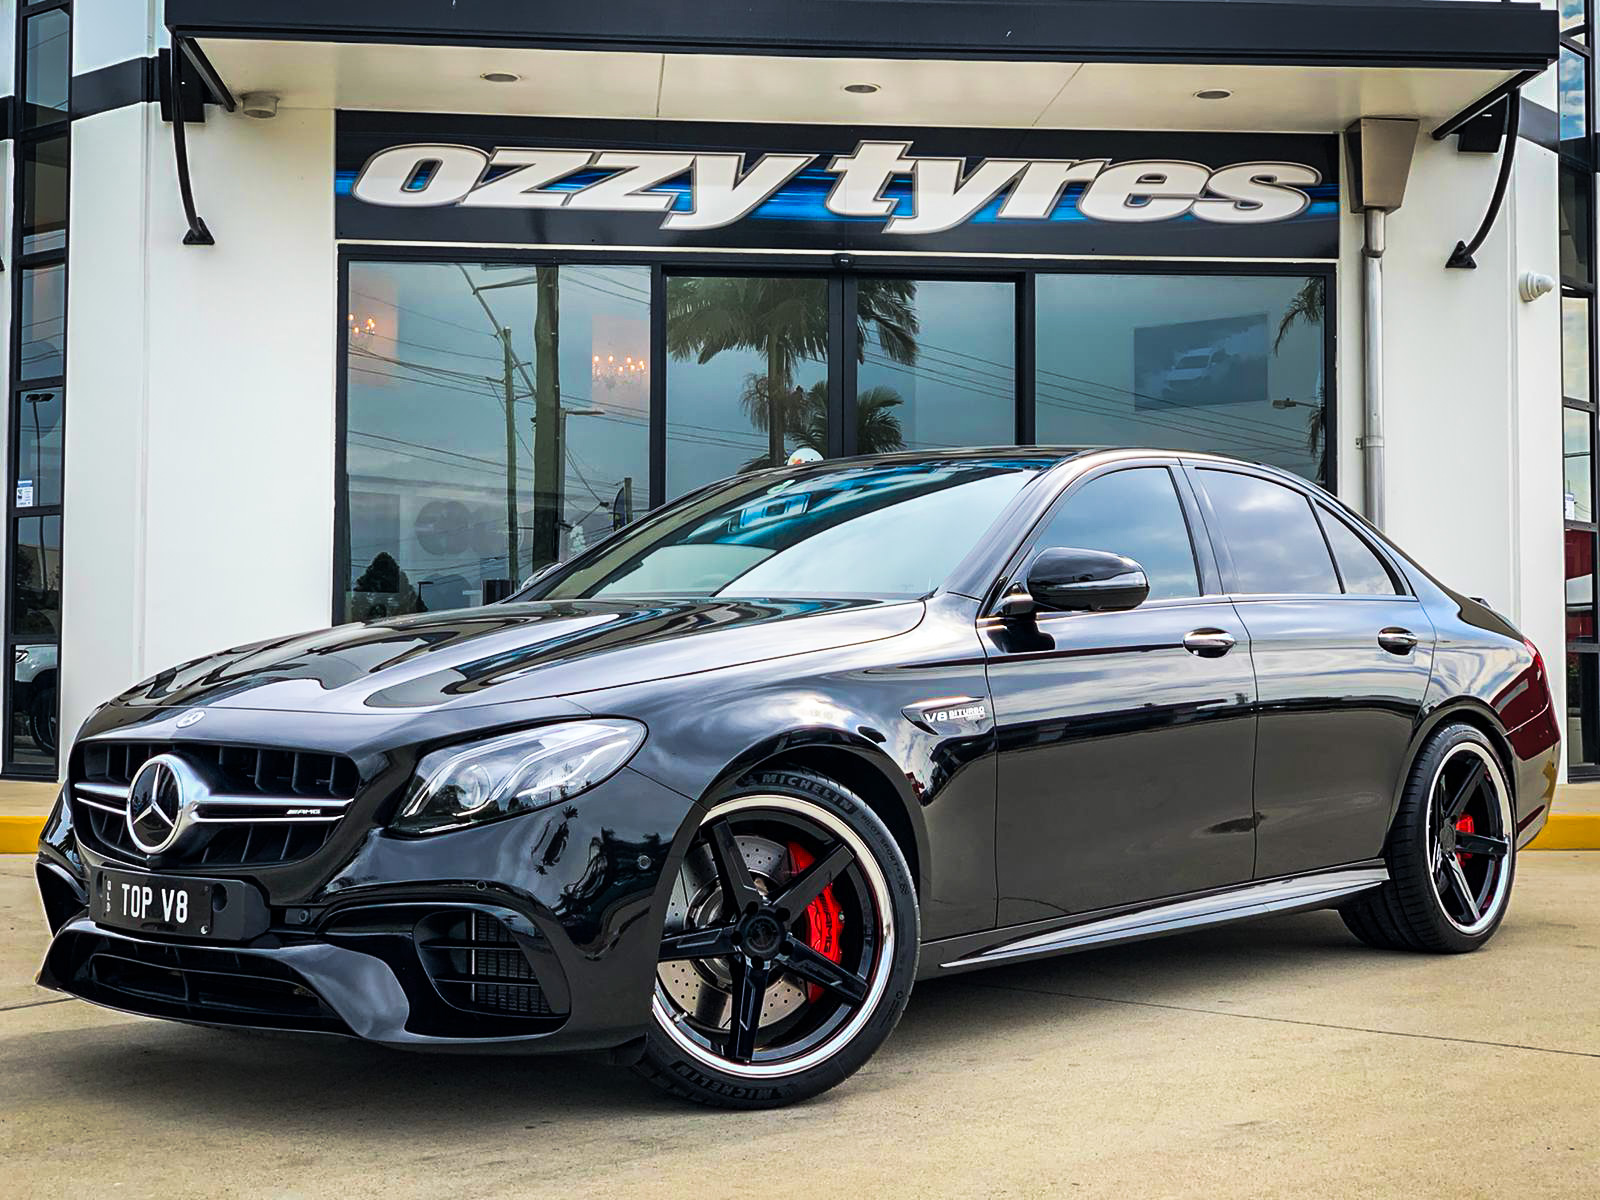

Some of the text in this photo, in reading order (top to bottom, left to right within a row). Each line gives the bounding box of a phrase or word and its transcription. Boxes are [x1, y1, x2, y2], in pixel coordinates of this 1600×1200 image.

[351, 139, 1322, 234] ozzy tyres
[925, 711, 948, 723] V8
[762, 774, 855, 812] MICHELIN
[121, 883, 188, 923] TOP V8
[824, 911, 833, 953] AMG
[676, 1062, 774, 1100] MICHELIN
